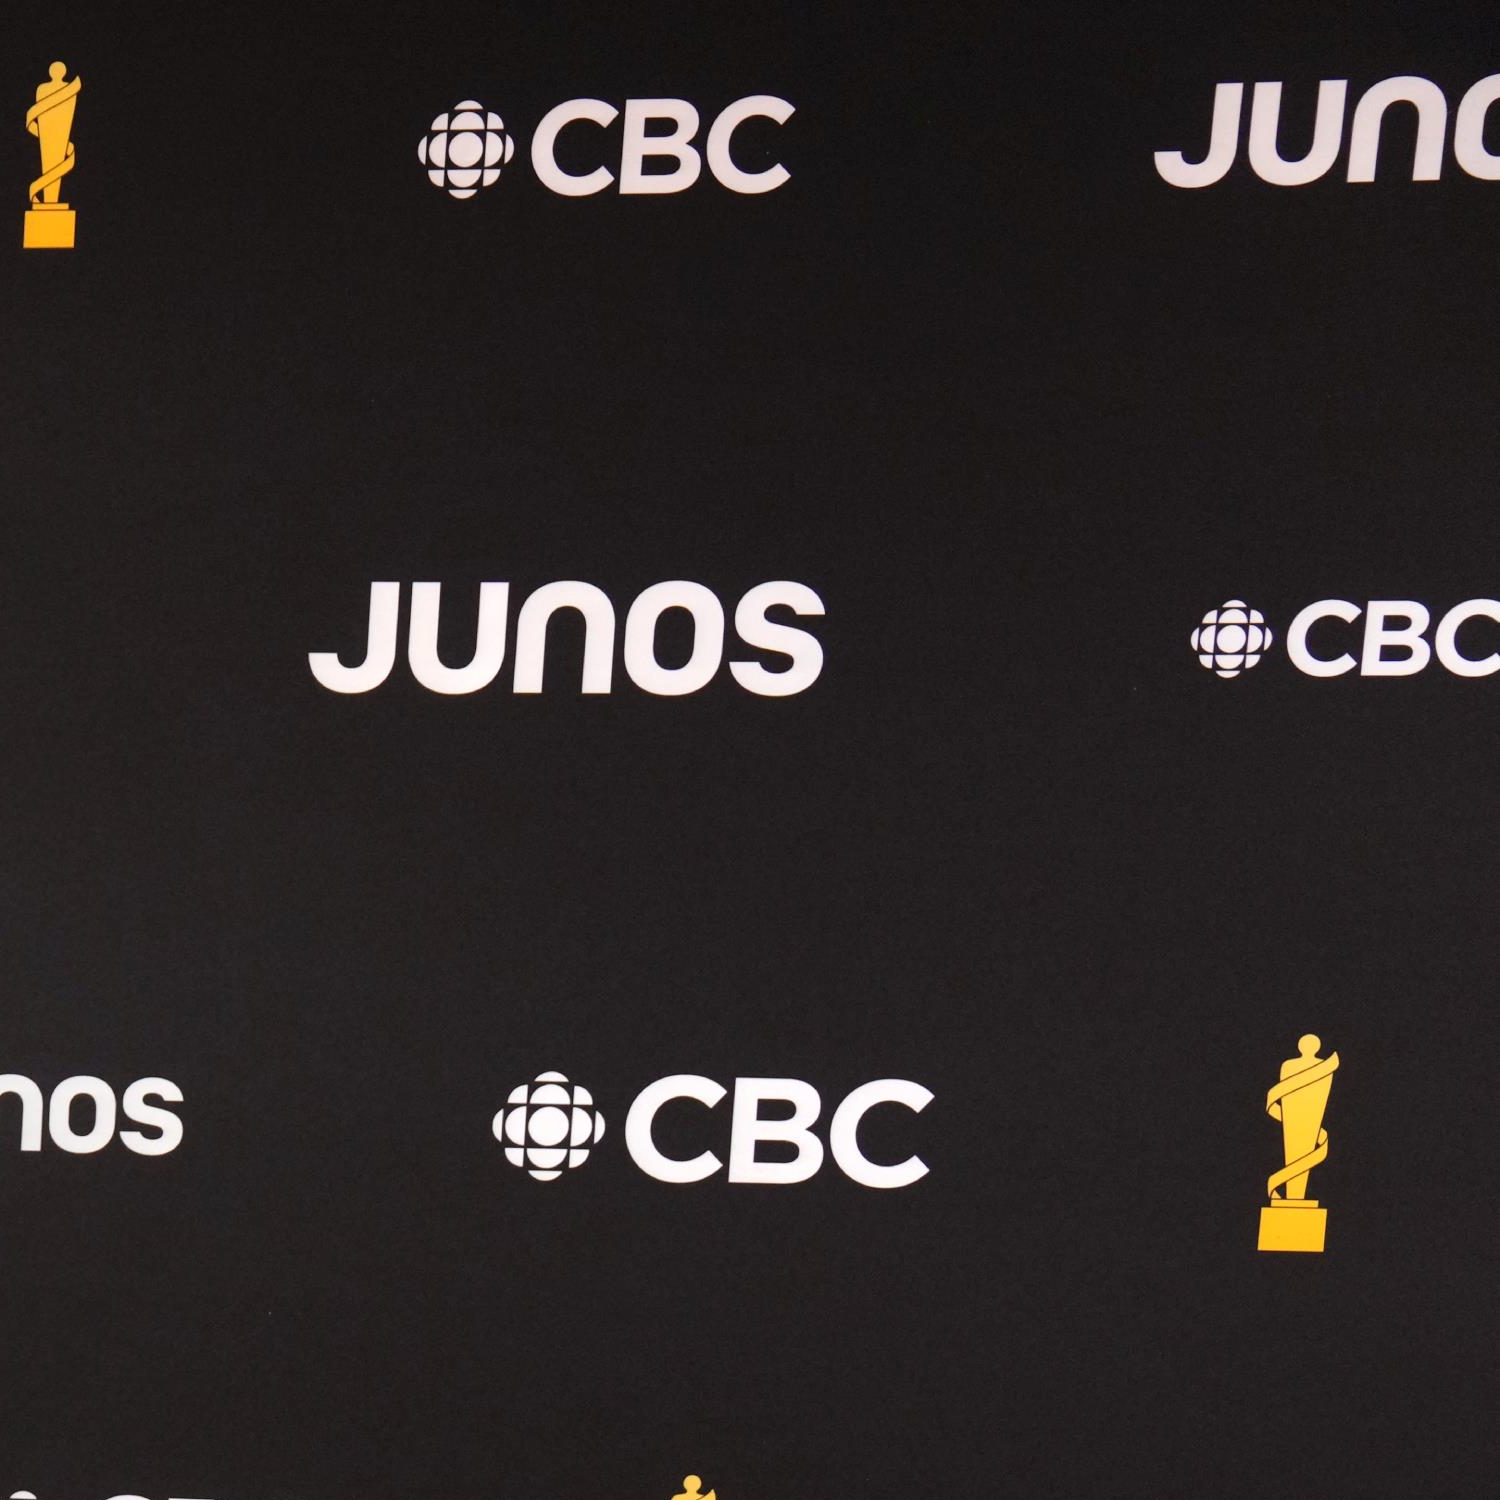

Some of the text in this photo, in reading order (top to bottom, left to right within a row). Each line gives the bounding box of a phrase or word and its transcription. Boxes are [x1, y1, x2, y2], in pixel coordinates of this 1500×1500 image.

[531, 94, 796, 197] CBC
[308, 580, 826, 697] JUNOS
[1286, 598, 1500, 678] CBC
[624, 1074, 935, 1189] CBC
